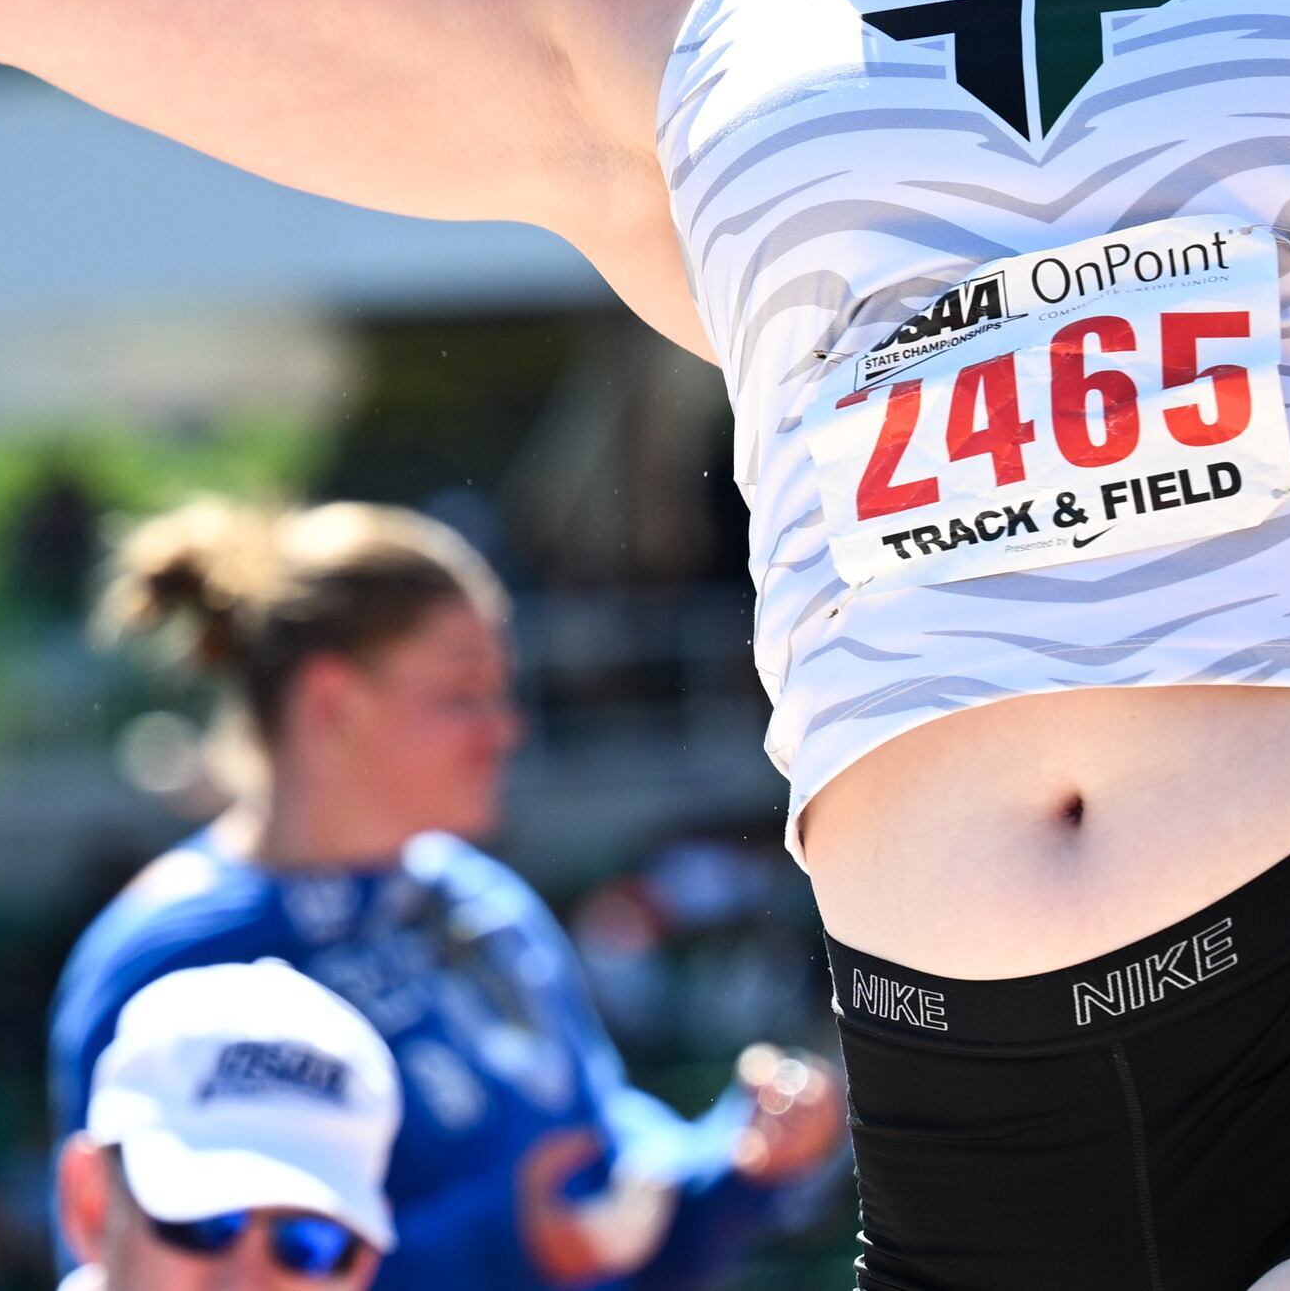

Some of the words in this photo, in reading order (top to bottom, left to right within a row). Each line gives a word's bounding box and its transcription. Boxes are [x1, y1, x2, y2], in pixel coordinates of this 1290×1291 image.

[1031, 231, 1229, 304] OnPoint
[1181, 275, 1230, 287] UNION
[864, 351, 900, 370] STATE
[902, 321, 1002, 359] CHAMPIONSHIPS
[835, 311, 1252, 522] 2465
[881, 499, 1040, 560] TRACK
[1053, 491, 1089, 528] &
[1100, 461, 1242, 520] FIELD
[1005, 539, 1053, 553] Presented
[852, 968, 949, 1032] NIKE
[1072, 917, 1239, 1026] NIKE
